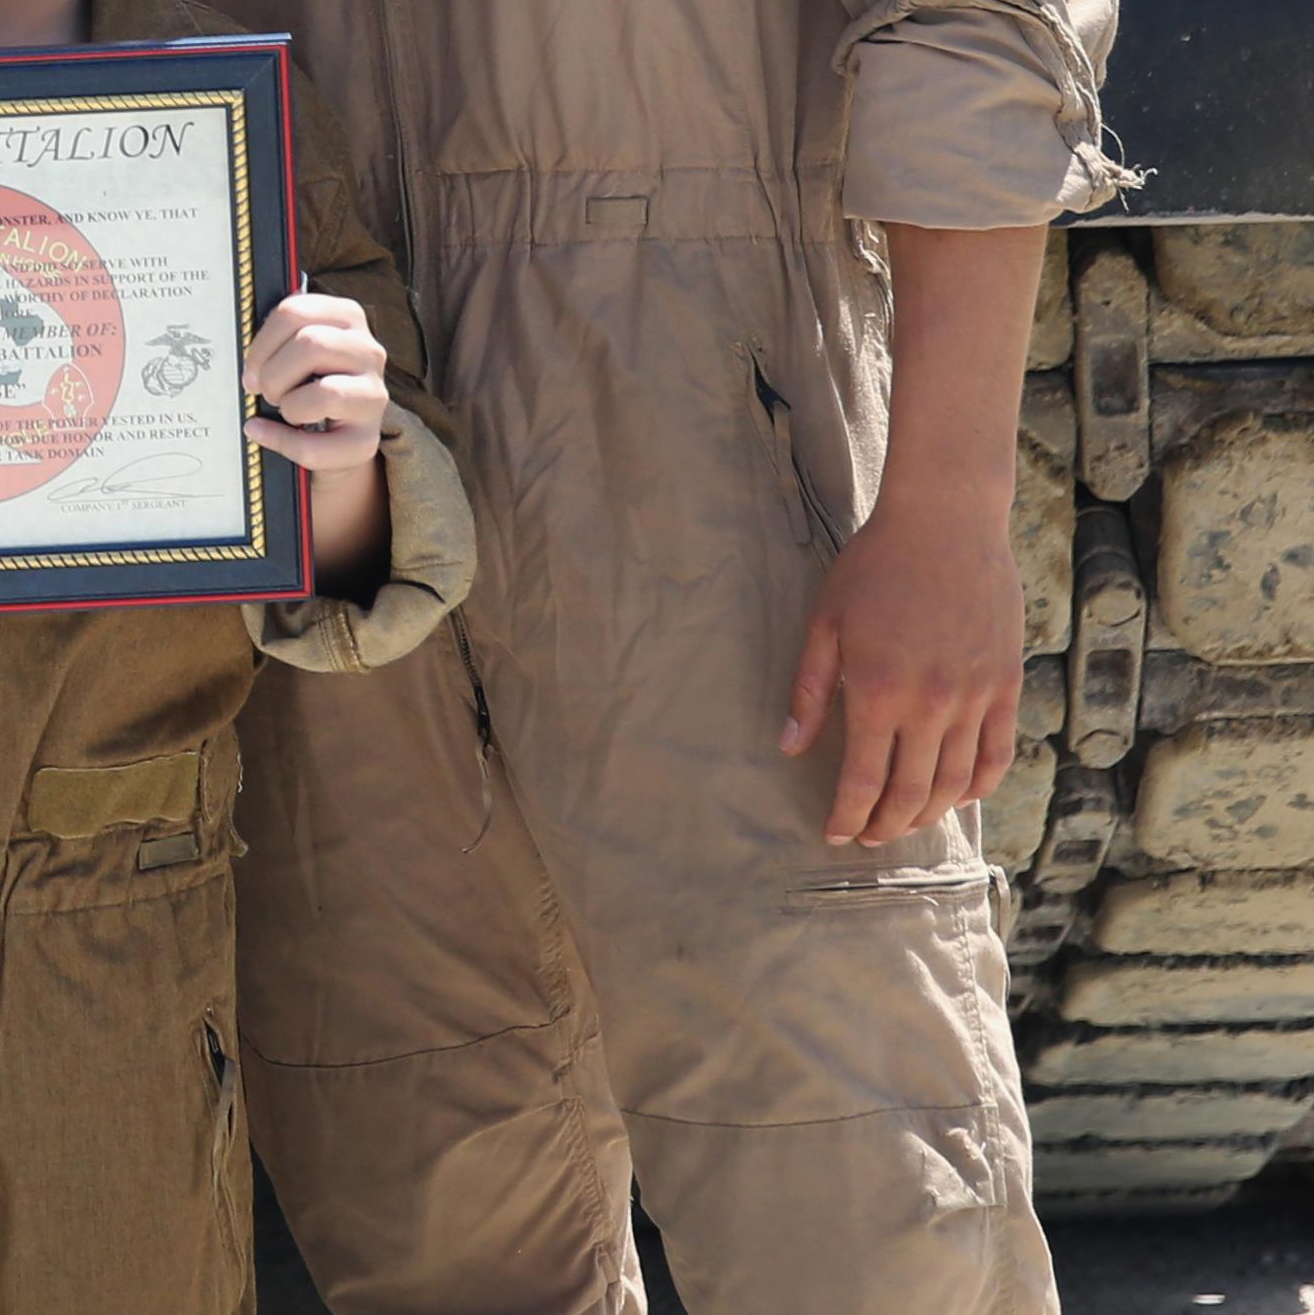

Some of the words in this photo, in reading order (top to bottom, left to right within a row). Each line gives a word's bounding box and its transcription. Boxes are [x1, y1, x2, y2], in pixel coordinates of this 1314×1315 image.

[56, 213, 84, 224] AND
[88, 211, 130, 223] KNOW
[134, 210, 156, 221] YE,
[160, 208, 198, 218] THAT
[1, 262, 29, 273] AND
[82, 258, 126, 269] SERVE
[130, 257, 168, 268] WITH
[6, 276, 70, 288] HAZARDS
[74, 276, 88, 286] IN
[93, 273, 156, 285] SUPPORT
[159, 272, 177, 282] OF
[181, 271, 209, 281] THE
[4, 292, 65, 305] WORTHY
[70, 291, 88, 302] OF
[92, 287, 192, 300] DECLARATION
[5, 324, 81, 339] MEMBER
[86, 323, 117, 336] OF:
[16, 419, 44, 430] THE
[103, 415, 155, 426] VESTED
[159, 414, 173, 424] IN
[31, 434, 59, 445] DUE
[63, 431, 113, 443] HONOR
[116, 430, 145, 441] AND
[149, 427, 211, 439] RESPECT
[6, 448, 43, 460] TANK
[48, 447, 105, 458] DOMAIN
[61, 502, 113, 513] COMPANY
[132, 500, 187, 511] SERGEANT
